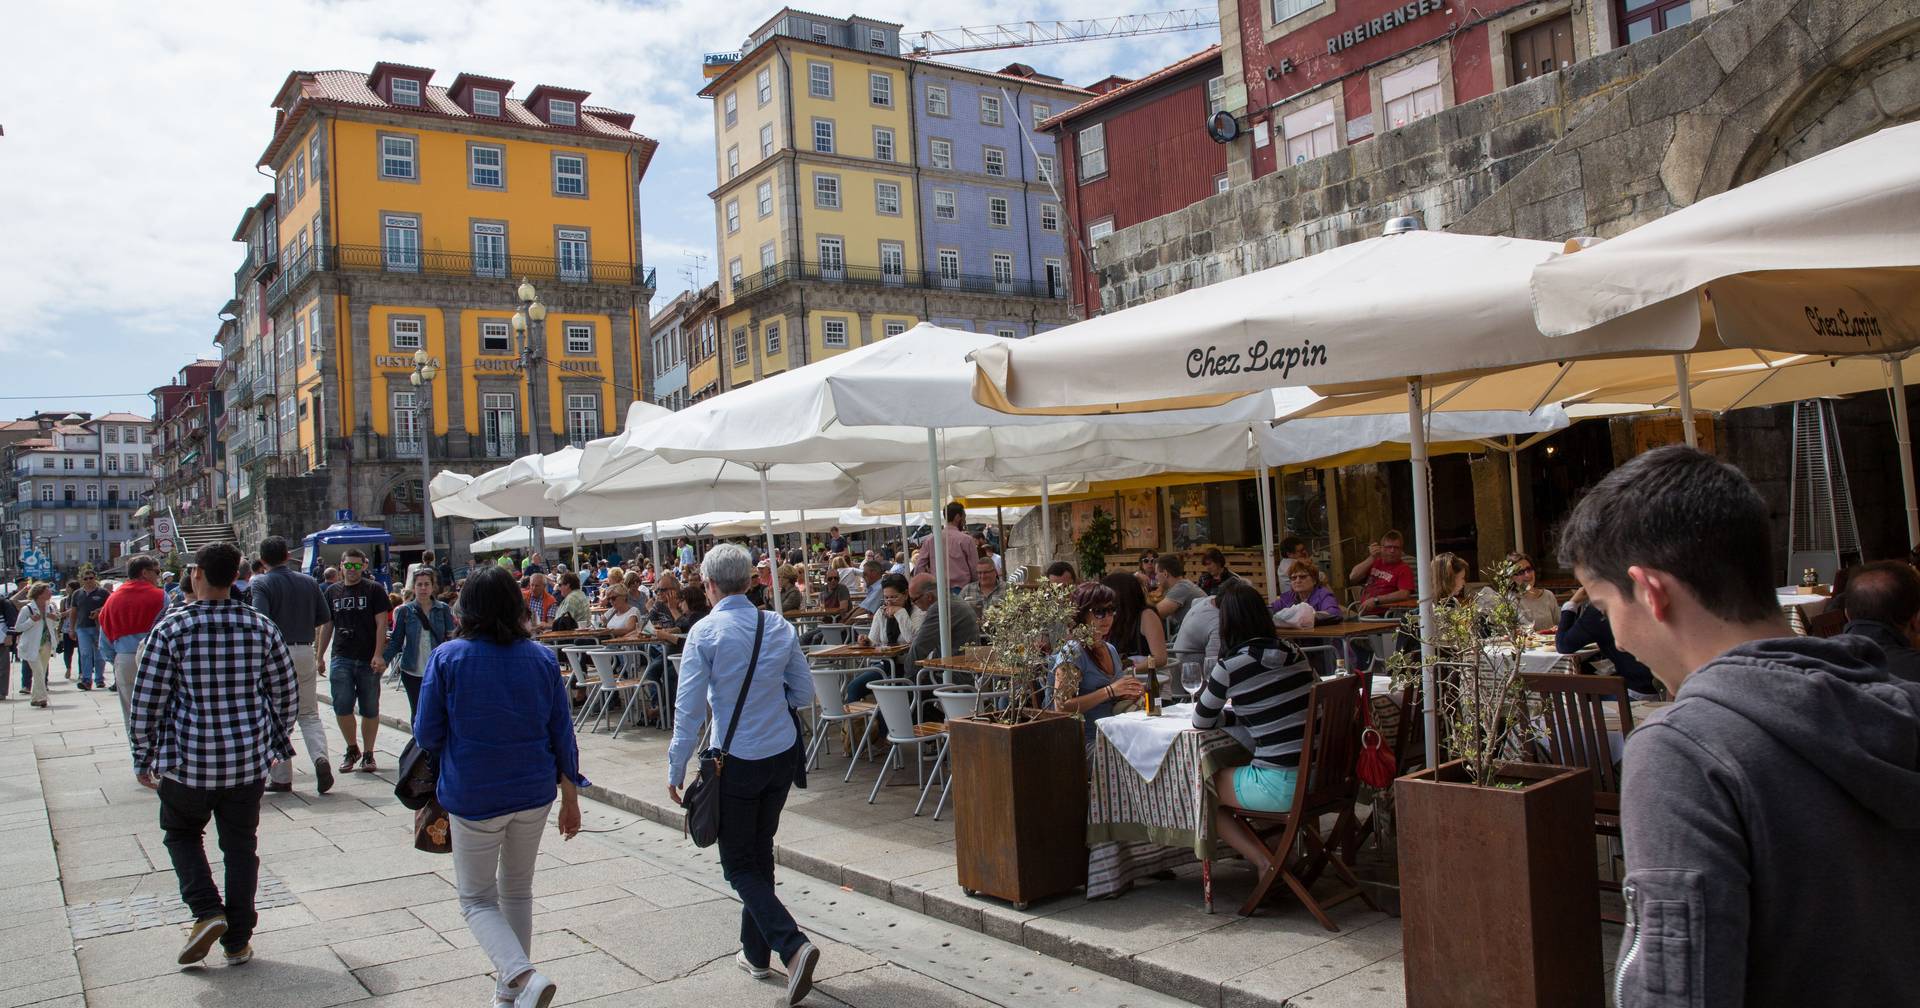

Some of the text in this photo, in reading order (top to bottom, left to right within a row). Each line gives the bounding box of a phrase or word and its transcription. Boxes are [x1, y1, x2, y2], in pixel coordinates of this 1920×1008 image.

[1327, 0, 1443, 56] RIBEIRENSES
[705, 53, 739, 62] POTAIN
[1804, 305, 1882, 347] Chez Lapin
[376, 355, 601, 372] PESTAA PORTO HOTEL
[1186, 339, 1328, 380] Chez Lapin
